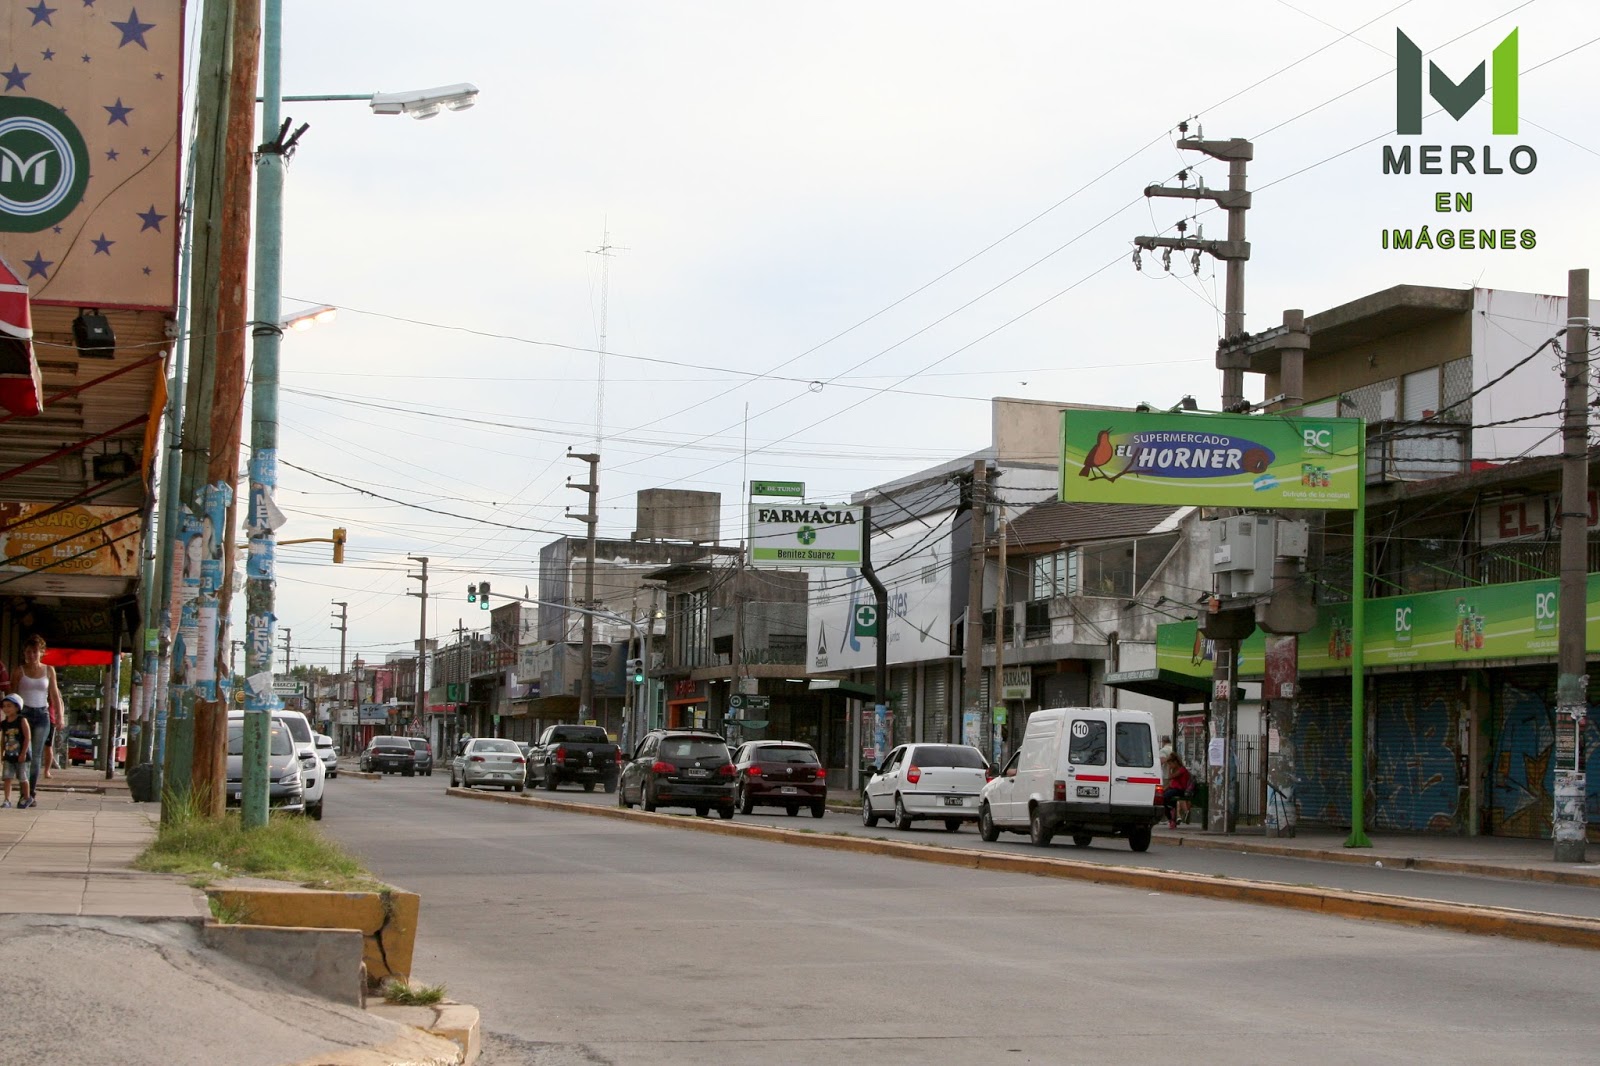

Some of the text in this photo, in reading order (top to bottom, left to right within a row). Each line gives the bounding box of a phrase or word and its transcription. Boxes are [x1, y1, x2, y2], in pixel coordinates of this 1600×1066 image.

[1133, 433, 1230, 446] SUPERMERCADO
[1303, 429, 1331, 447] BC
[1115, 445, 1133, 457] EL
[7, 511, 103, 534] RECARGA
[758, 509, 856, 524] FARMACIA
[1499, 503, 1540, 538] EL
[32, 557, 48, 567] EL
[54, 558, 94, 569] ACTO
[1535, 592, 1555, 620] BC
[1395, 607, 1412, 631] BC
[1073, 724, 1088, 735] 110
